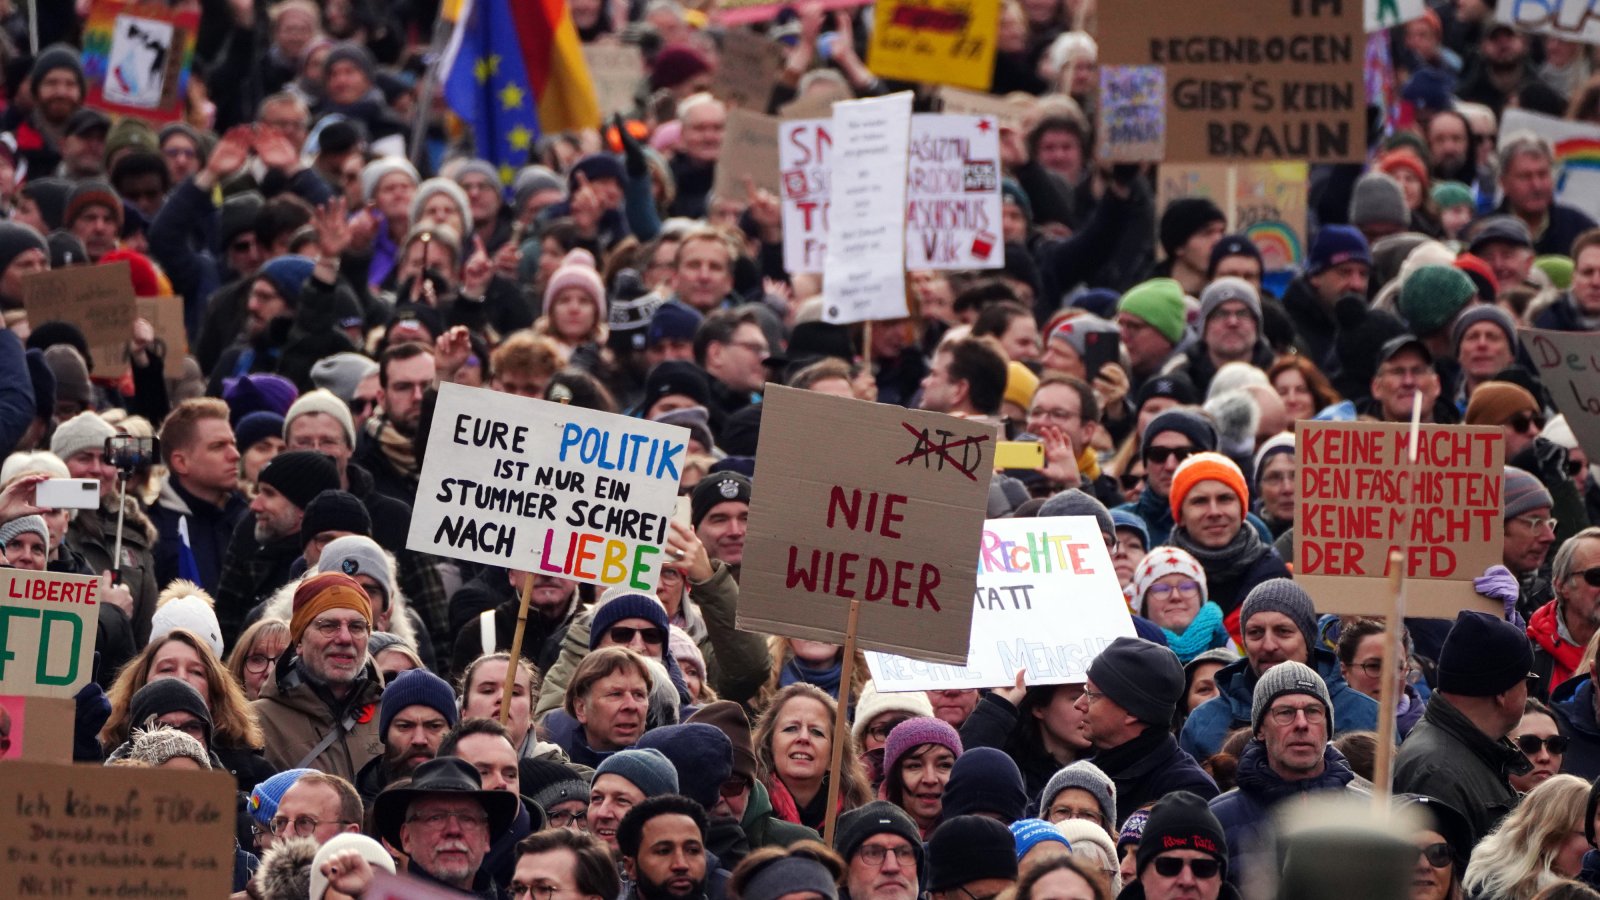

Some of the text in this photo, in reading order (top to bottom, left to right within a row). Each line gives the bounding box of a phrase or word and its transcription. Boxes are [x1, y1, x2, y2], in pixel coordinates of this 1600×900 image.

[1150, 35, 1352, 63] REGENBOGEN
[1172, 74, 1353, 112] GIBT'S KEIN
[1207, 121, 1350, 157] BRAUN
[453, 413, 684, 480] EURE POLITIK
[1302, 428, 1503, 468] KEINE MACHT
[493, 458, 630, 502] IST NUR EIN
[1301, 467, 1501, 508] DEN FASCHISTEN
[435, 477, 667, 545] STUMMER SCHREI
[826, 485, 908, 539] NIE
[1302, 503, 1499, 544] KEINE MACHT
[433, 515, 660, 590] NACH LIEBE
[977, 530, 1095, 574] RECHTE
[1301, 540, 1365, 575] DER
[9, 578, 98, 605] LIBERTÉ
[785, 545, 941, 612] WIEDER
[16, 791, 51, 818] Ich
[63, 787, 142, 824] kämpfe
[28, 823, 156, 848] Demokratie
[1163, 835, 1187, 848] Rose
